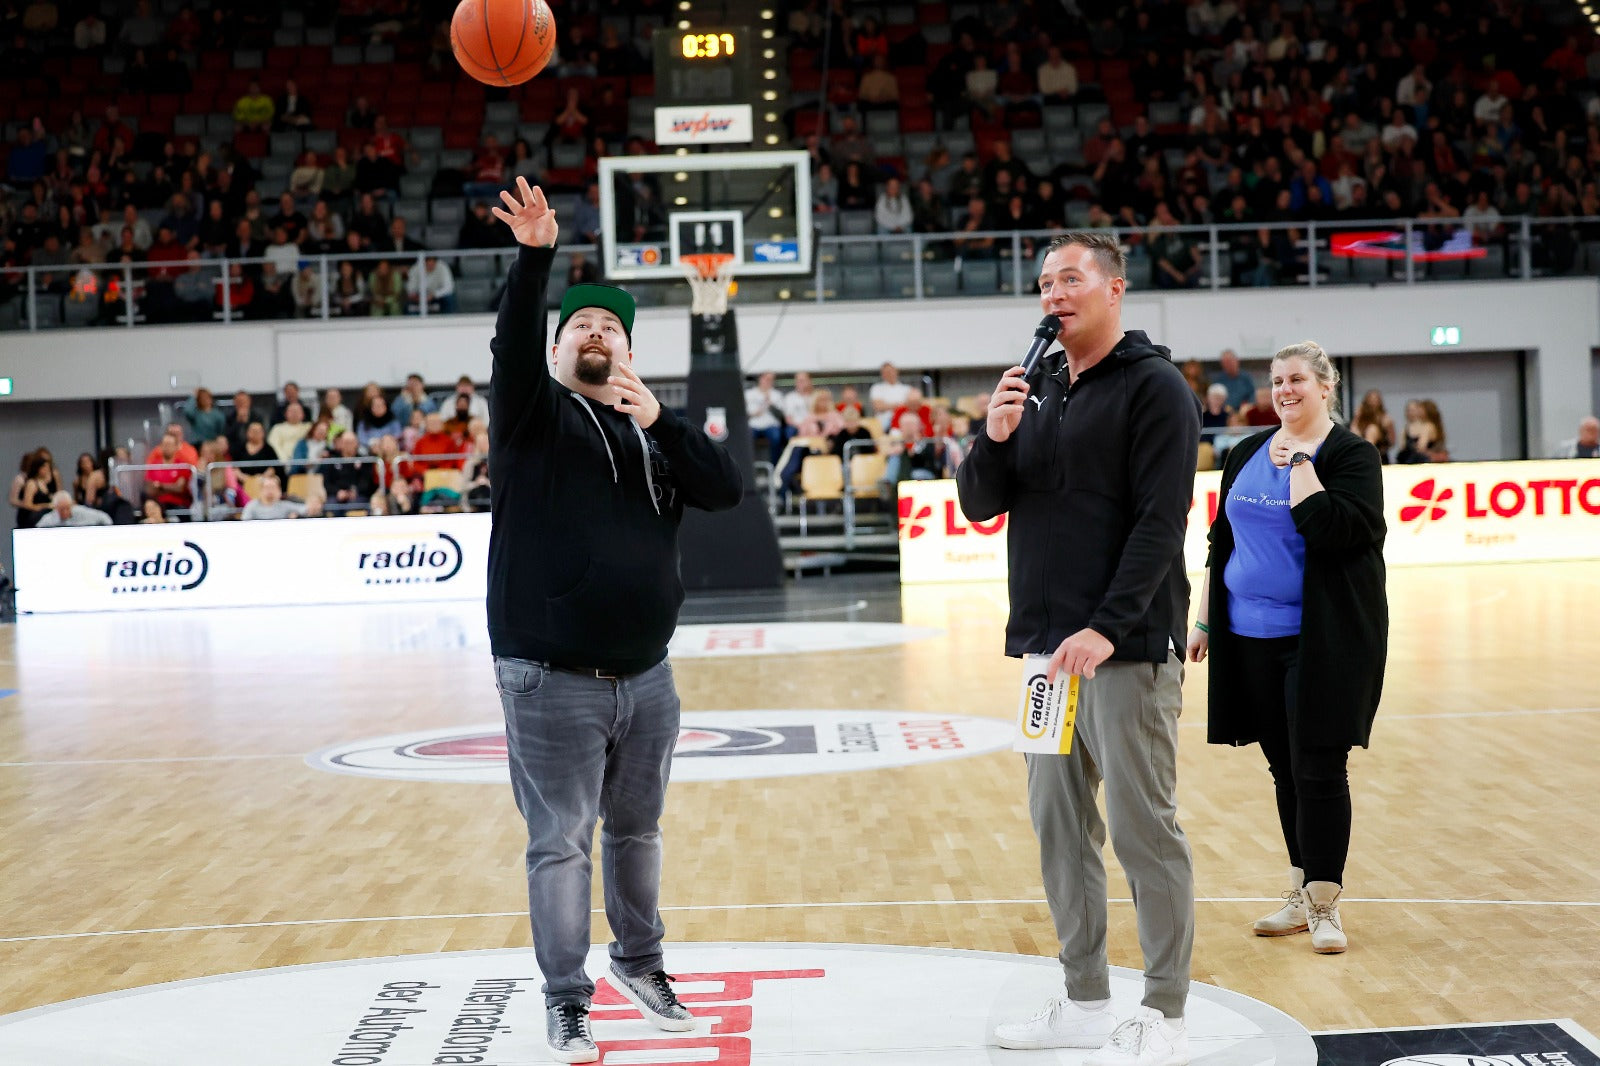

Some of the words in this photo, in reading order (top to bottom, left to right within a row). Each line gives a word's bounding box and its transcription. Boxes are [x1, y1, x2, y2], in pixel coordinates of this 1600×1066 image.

[682, 33, 735, 58] 0:37
[1233, 494, 1258, 504] LUKAS
[1466, 478, 1600, 518] LOTTO
[105, 552, 193, 578] radio
[359, 544, 447, 569] radio
[1031, 681, 1046, 729] radio
[1044, 691, 1053, 726] BAMBERG
[374, 981, 441, 1003] der
[331, 1006, 428, 1066] Automo
